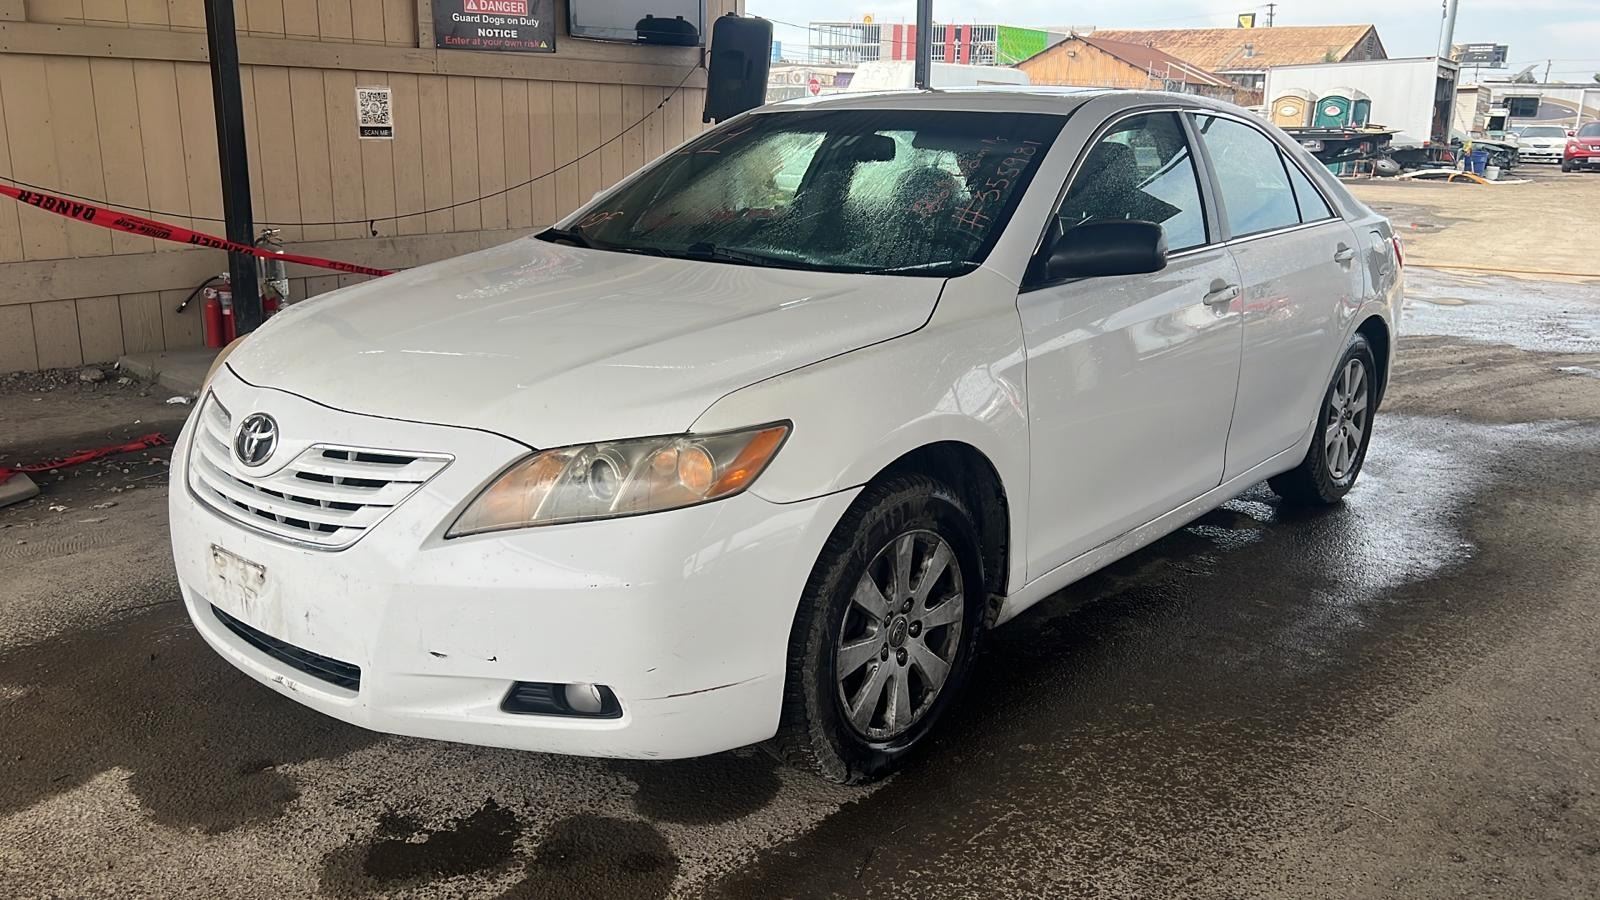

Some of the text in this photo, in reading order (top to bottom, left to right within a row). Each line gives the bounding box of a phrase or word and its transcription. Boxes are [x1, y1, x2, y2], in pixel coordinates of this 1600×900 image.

[480, 1, 525, 13] DANGER
[452, 13, 539, 28] Guard Dogs on Duty
[478, 28, 518, 38] NOTICE
[445, 36, 540, 48] Enter at your own risk
[17, 190, 97, 221] DANGER
